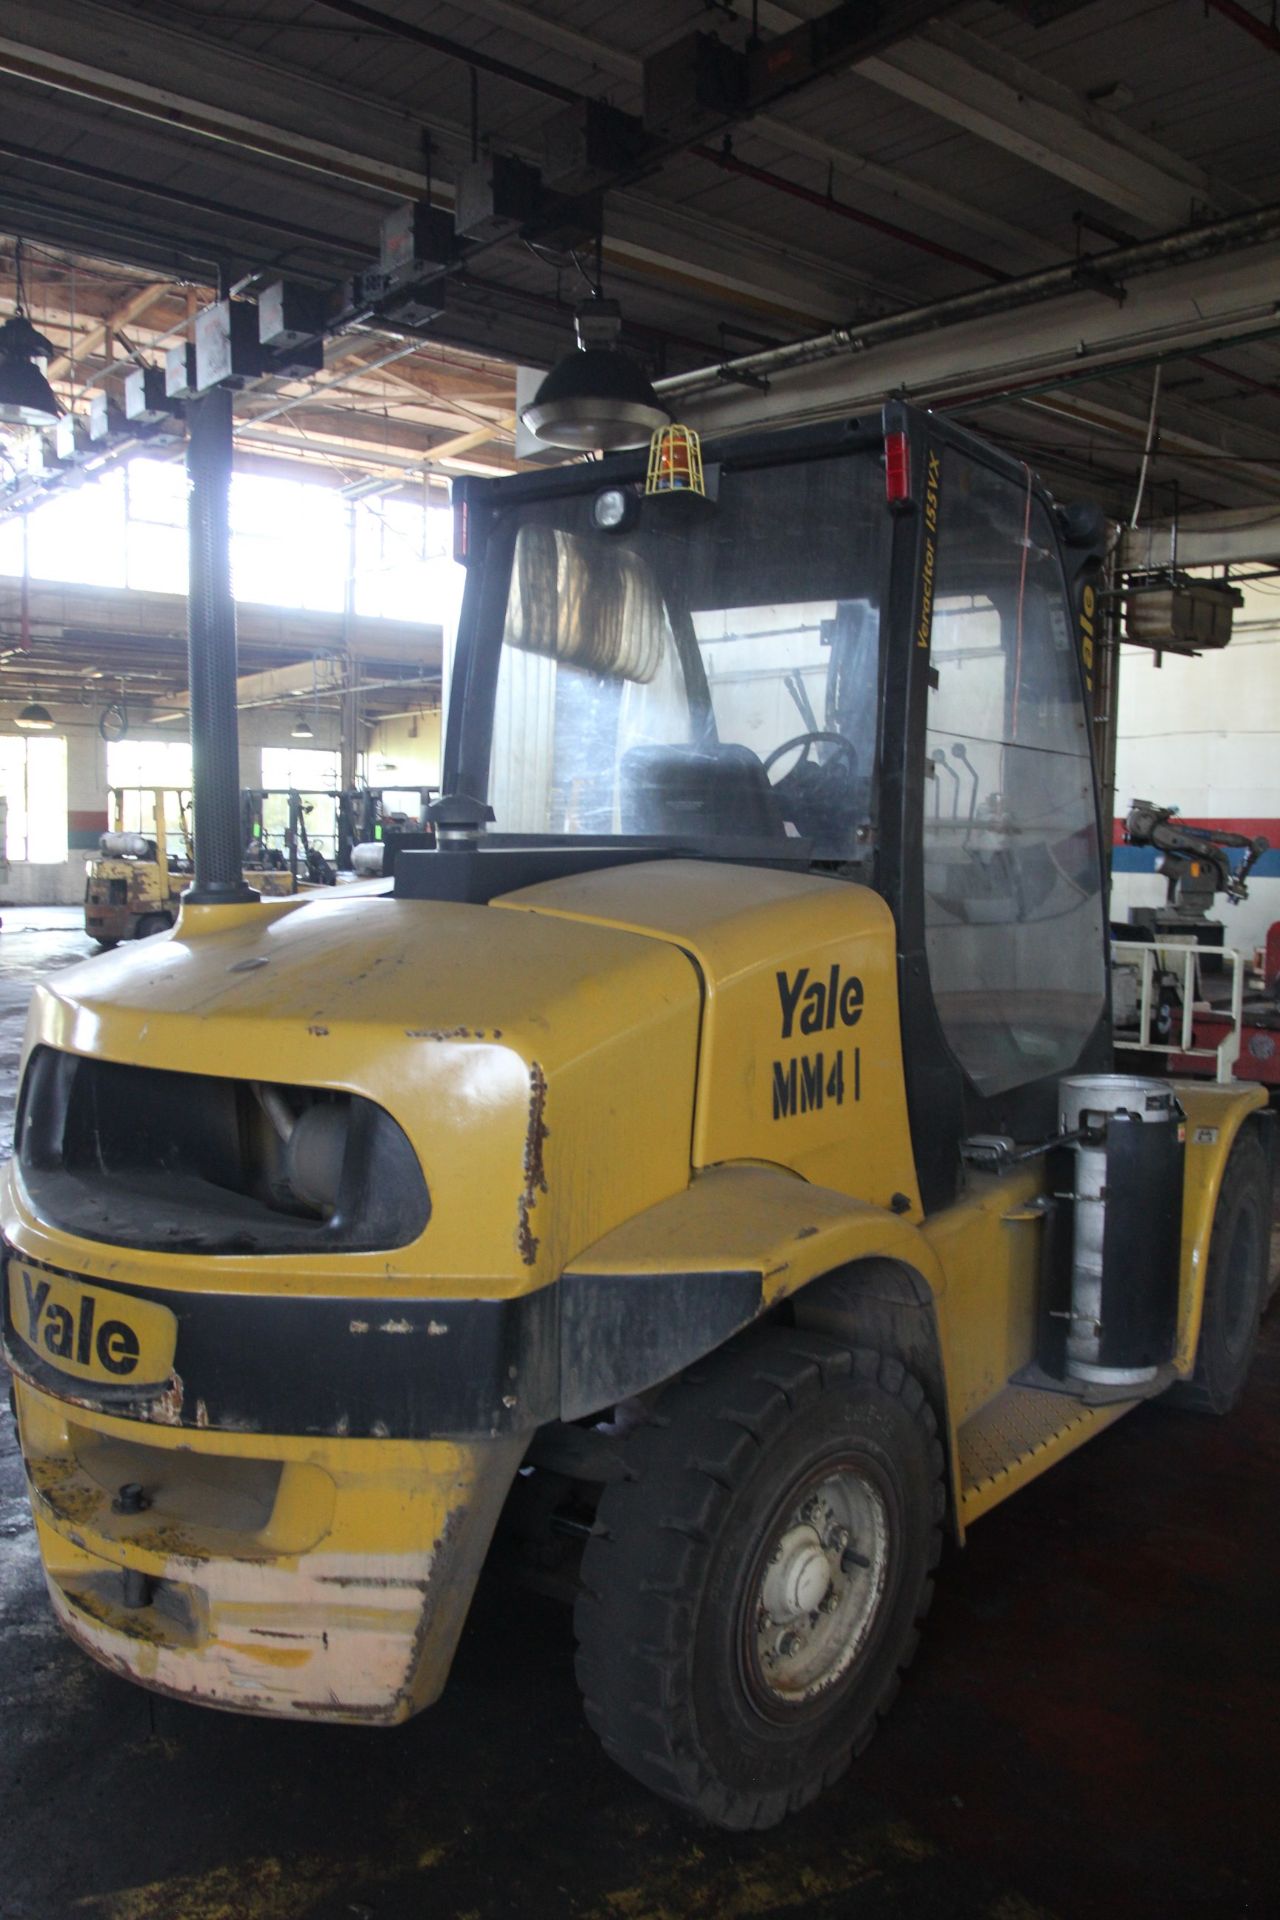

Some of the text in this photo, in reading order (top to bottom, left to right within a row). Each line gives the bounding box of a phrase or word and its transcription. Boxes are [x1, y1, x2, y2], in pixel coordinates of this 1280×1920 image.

[917, 449, 940, 648] Veracitor 155VX
[776, 964, 864, 1039] Yale
[22, 1271, 140, 1375] Yale
